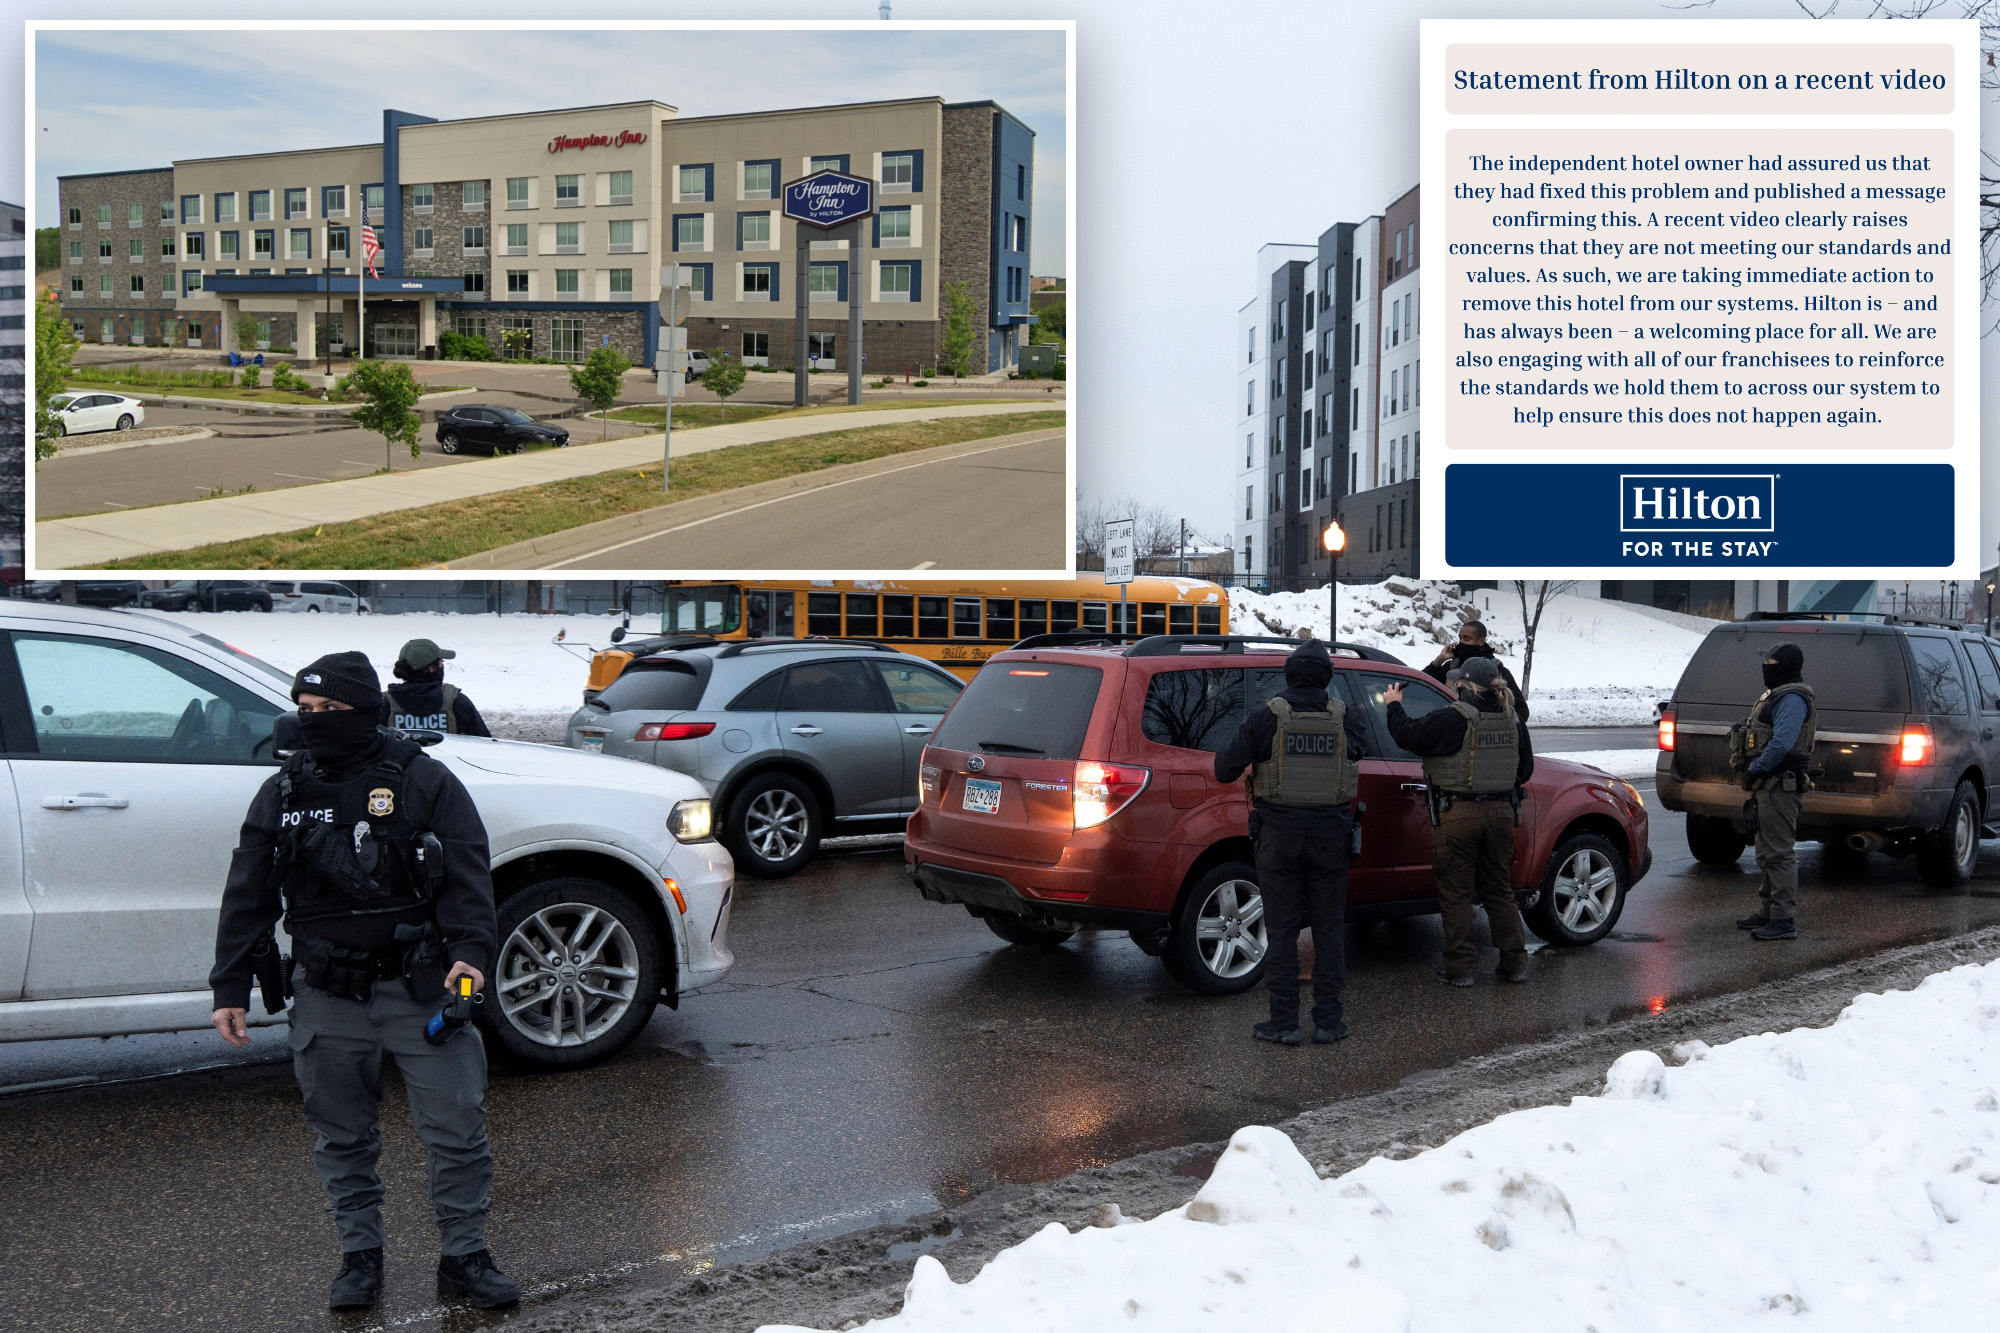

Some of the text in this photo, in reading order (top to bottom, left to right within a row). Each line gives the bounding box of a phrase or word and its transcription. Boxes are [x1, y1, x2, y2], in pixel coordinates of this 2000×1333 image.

[548, 129, 647, 153] Hampton Inn
[794, 181, 860, 200] Hampton
[808, 195, 845, 211] Inn
[1107, 527, 1132, 541] LEFT LANE
[1111, 545, 1127, 559] MUST
[1106, 564, 1132, 577] TURN LEFT
[941, 646, 967, 659] Bille
[394, 713, 448, 729] POLICE
[1287, 735, 1334, 754] POLICE
[1478, 732, 1514, 746] POLICE
[1025, 782, 1068, 792] FORESTER
[965, 786, 999, 807] RBZ 288
[281, 808, 334, 828] POICE
